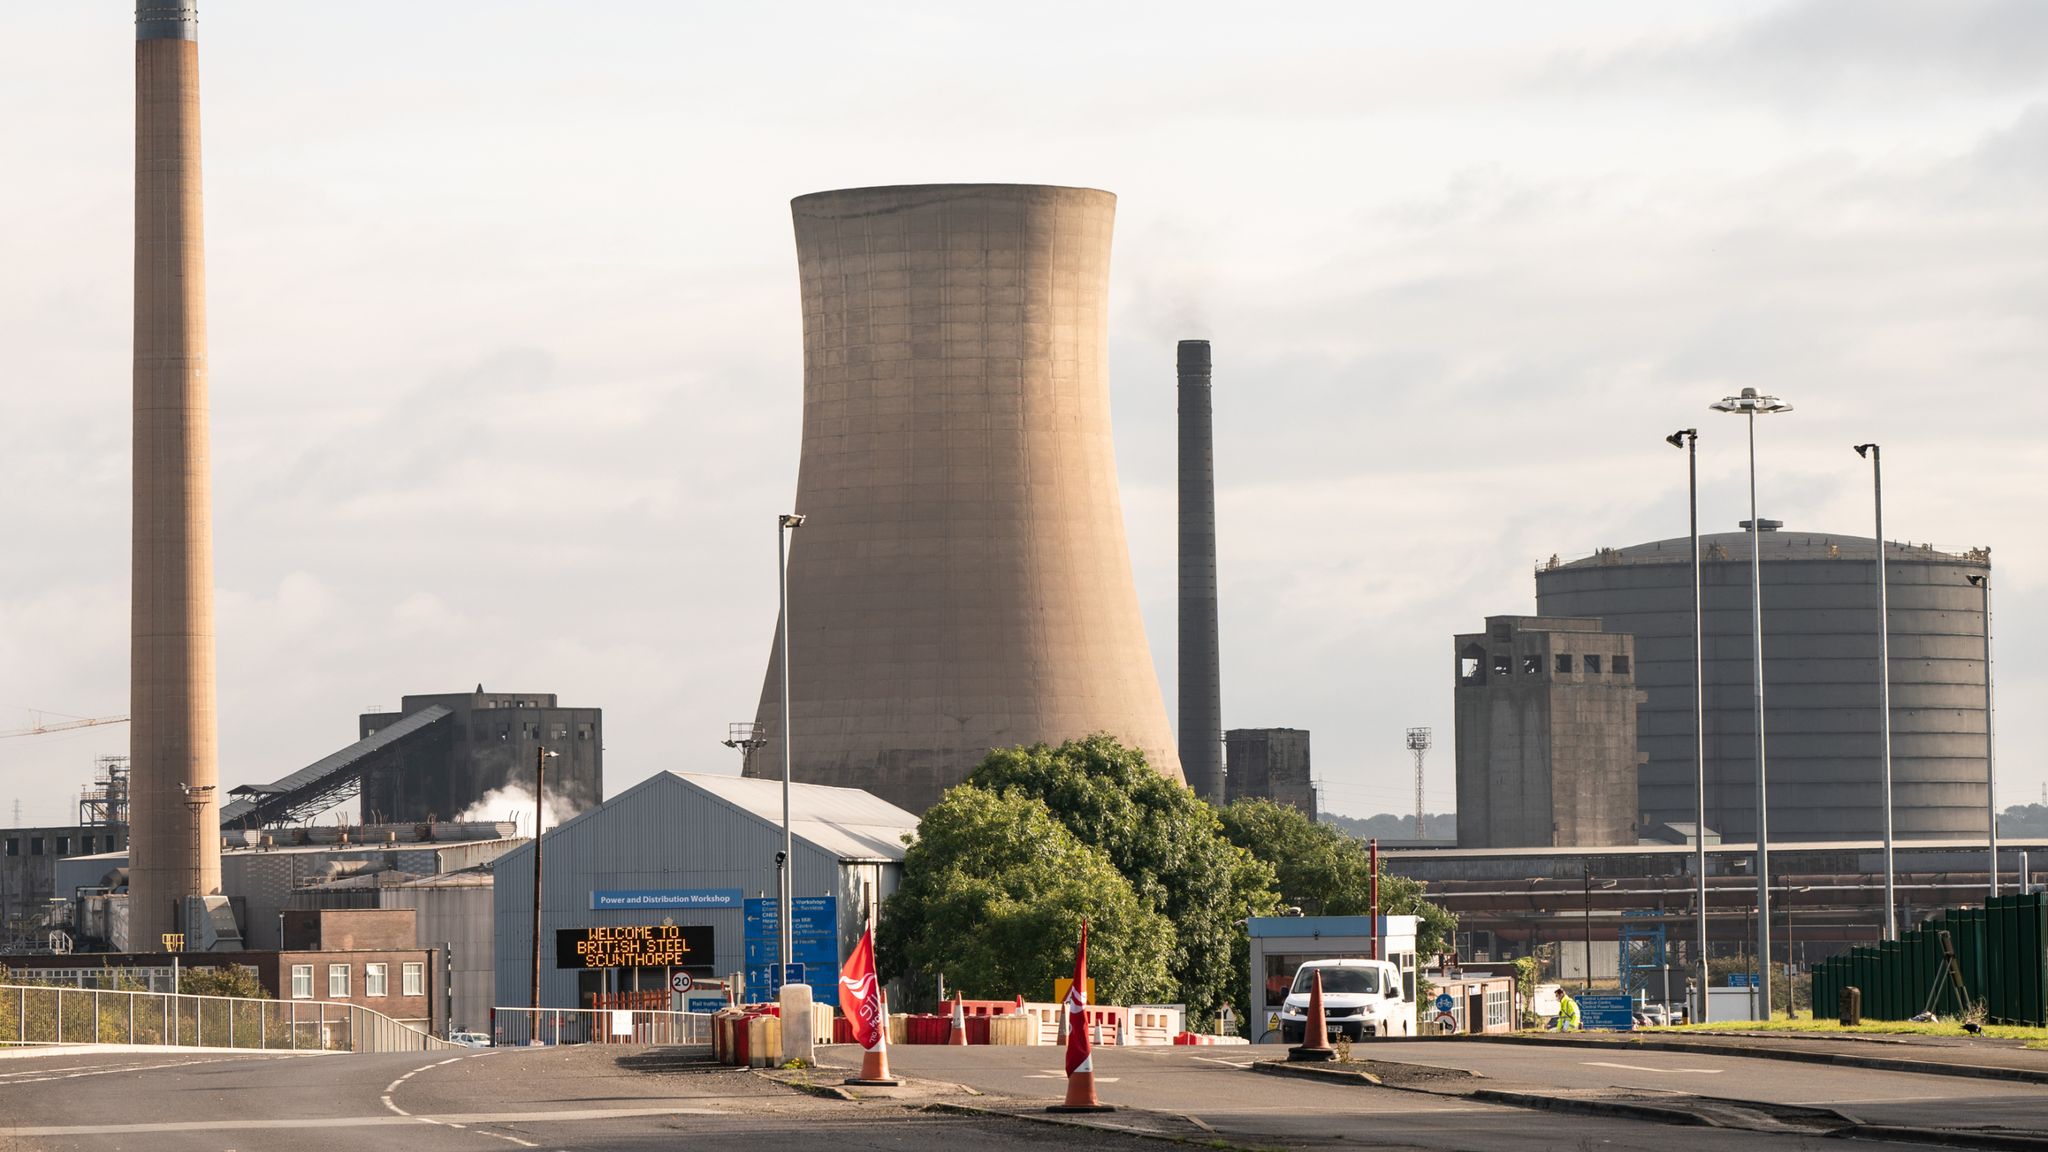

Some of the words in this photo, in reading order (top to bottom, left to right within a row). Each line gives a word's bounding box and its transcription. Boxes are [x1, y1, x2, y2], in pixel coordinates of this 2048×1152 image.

[600, 896, 625, 904] Power
[626, 896, 640, 904] and
[642, 895, 690, 904] Distribution
[690, 895, 731, 904] Workshop
[588, 926, 653, 940] WELCOME
[659, 925, 680, 939] TO
[577, 940, 640, 955] BRITISH
[646, 939, 691, 952] STEEL
[586, 952, 683, 967] SCUNTHORPE
[674, 976, 690, 987] 20
